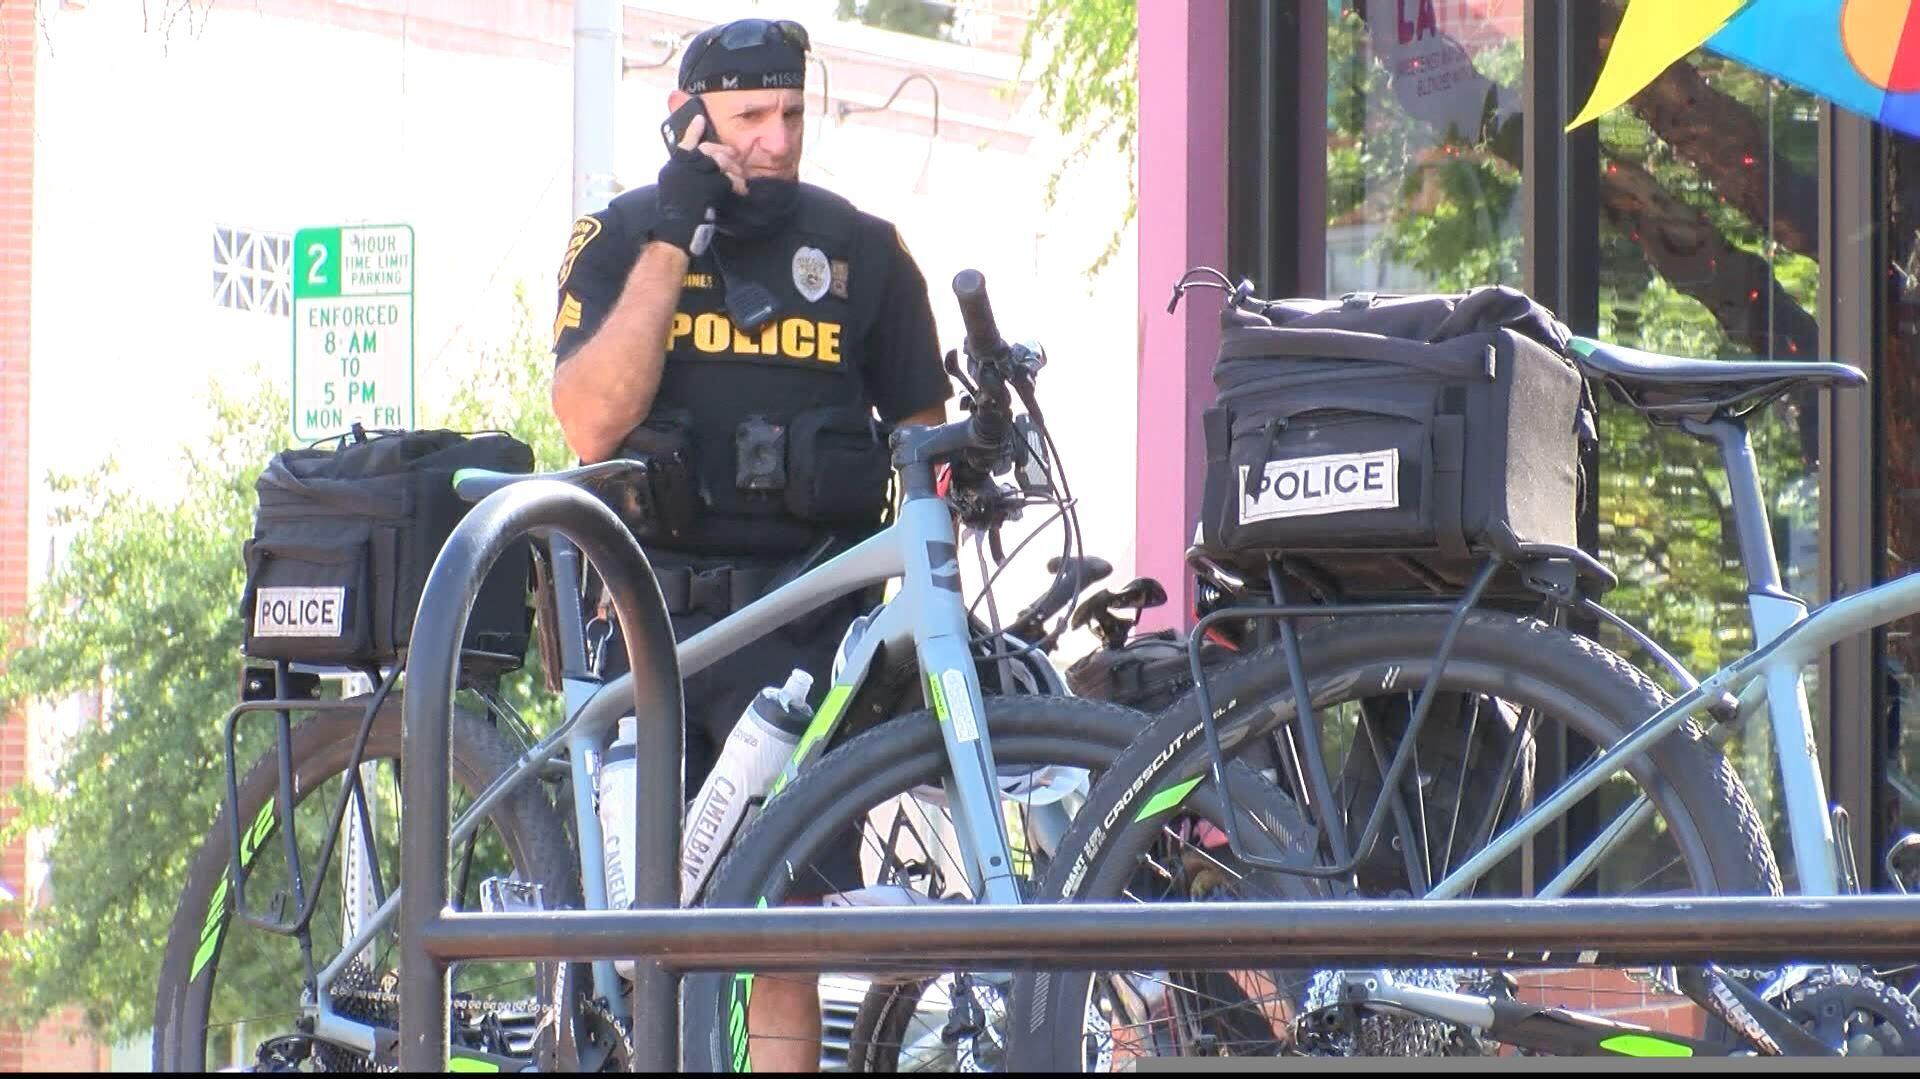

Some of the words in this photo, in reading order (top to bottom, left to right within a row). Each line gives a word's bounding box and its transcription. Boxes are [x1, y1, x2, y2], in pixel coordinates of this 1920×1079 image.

[355, 234, 396, 254] HOUR
[308, 243, 328, 285] 2
[345, 255, 371, 271] TIME
[378, 253, 409, 269] LIMIT
[351, 270, 402, 286] PARKING
[308, 305, 399, 328] ENFORCED
[324, 331, 336, 354] 8
[349, 331, 377, 353] AM
[665, 312, 841, 363] POLICE
[341, 357, 361, 377] TO
[324, 382, 335, 404] 5
[349, 381, 376, 404] PM
[306, 408, 343, 428] MON
[374, 407, 401, 425] FRI
[1254, 461, 1384, 504] POLICE
[262, 599, 335, 625] POLICE
[1104, 732, 1186, 829] CROSSCUT
[1062, 853, 1085, 898] GIANT
